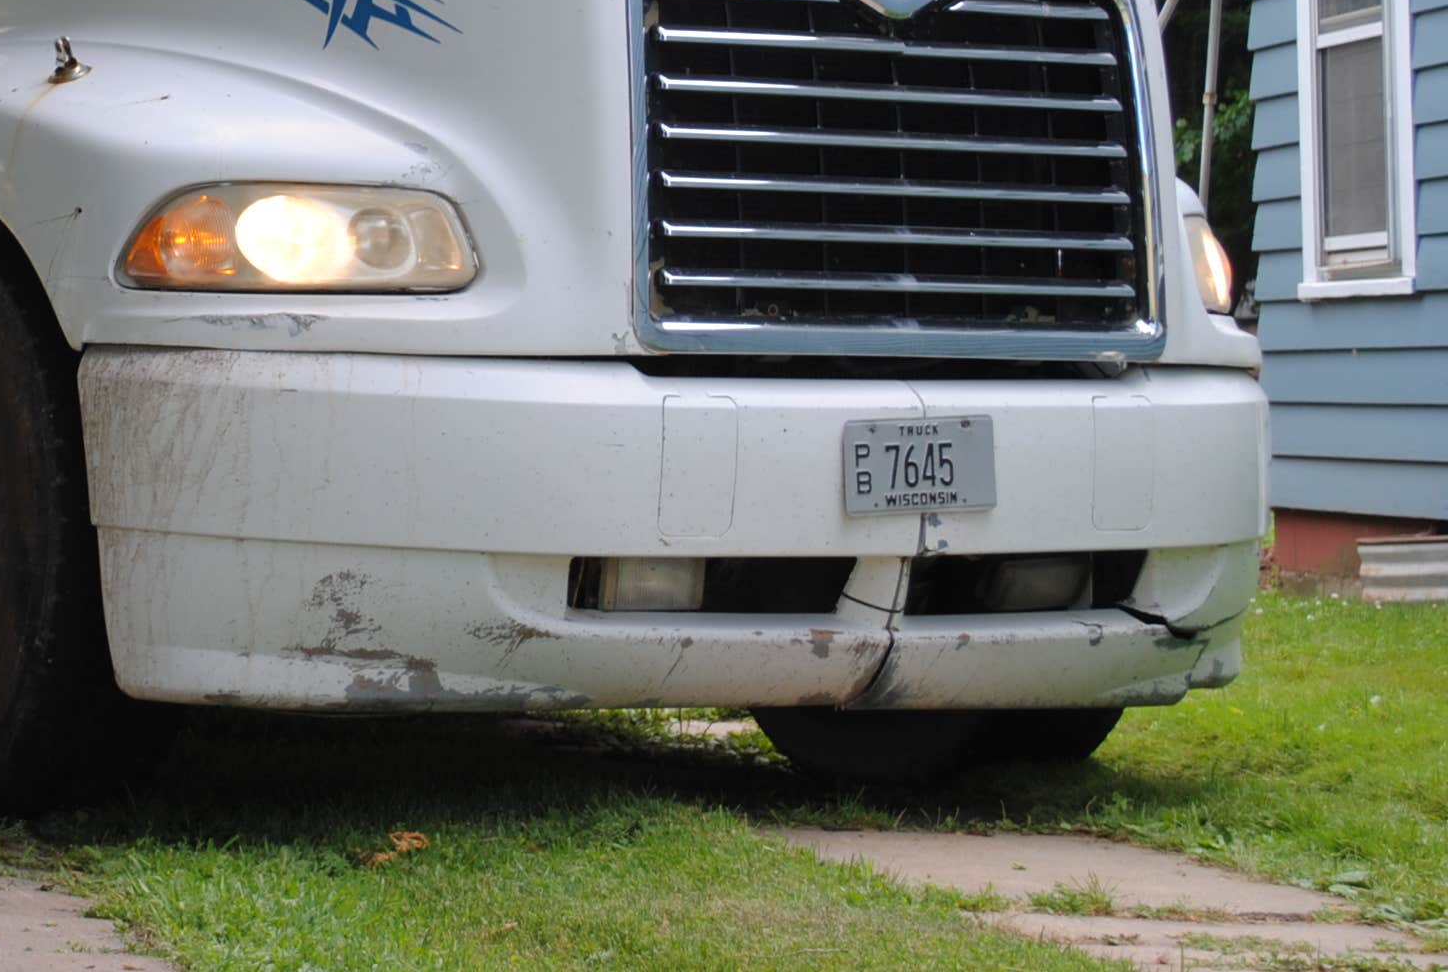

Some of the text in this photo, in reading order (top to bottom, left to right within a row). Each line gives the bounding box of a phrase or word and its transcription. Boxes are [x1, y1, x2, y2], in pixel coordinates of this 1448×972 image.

[898, 424, 940, 437] TRUCK
[884, 442, 954, 490] 7645
[884, 491, 959, 508] WISCONSIN
